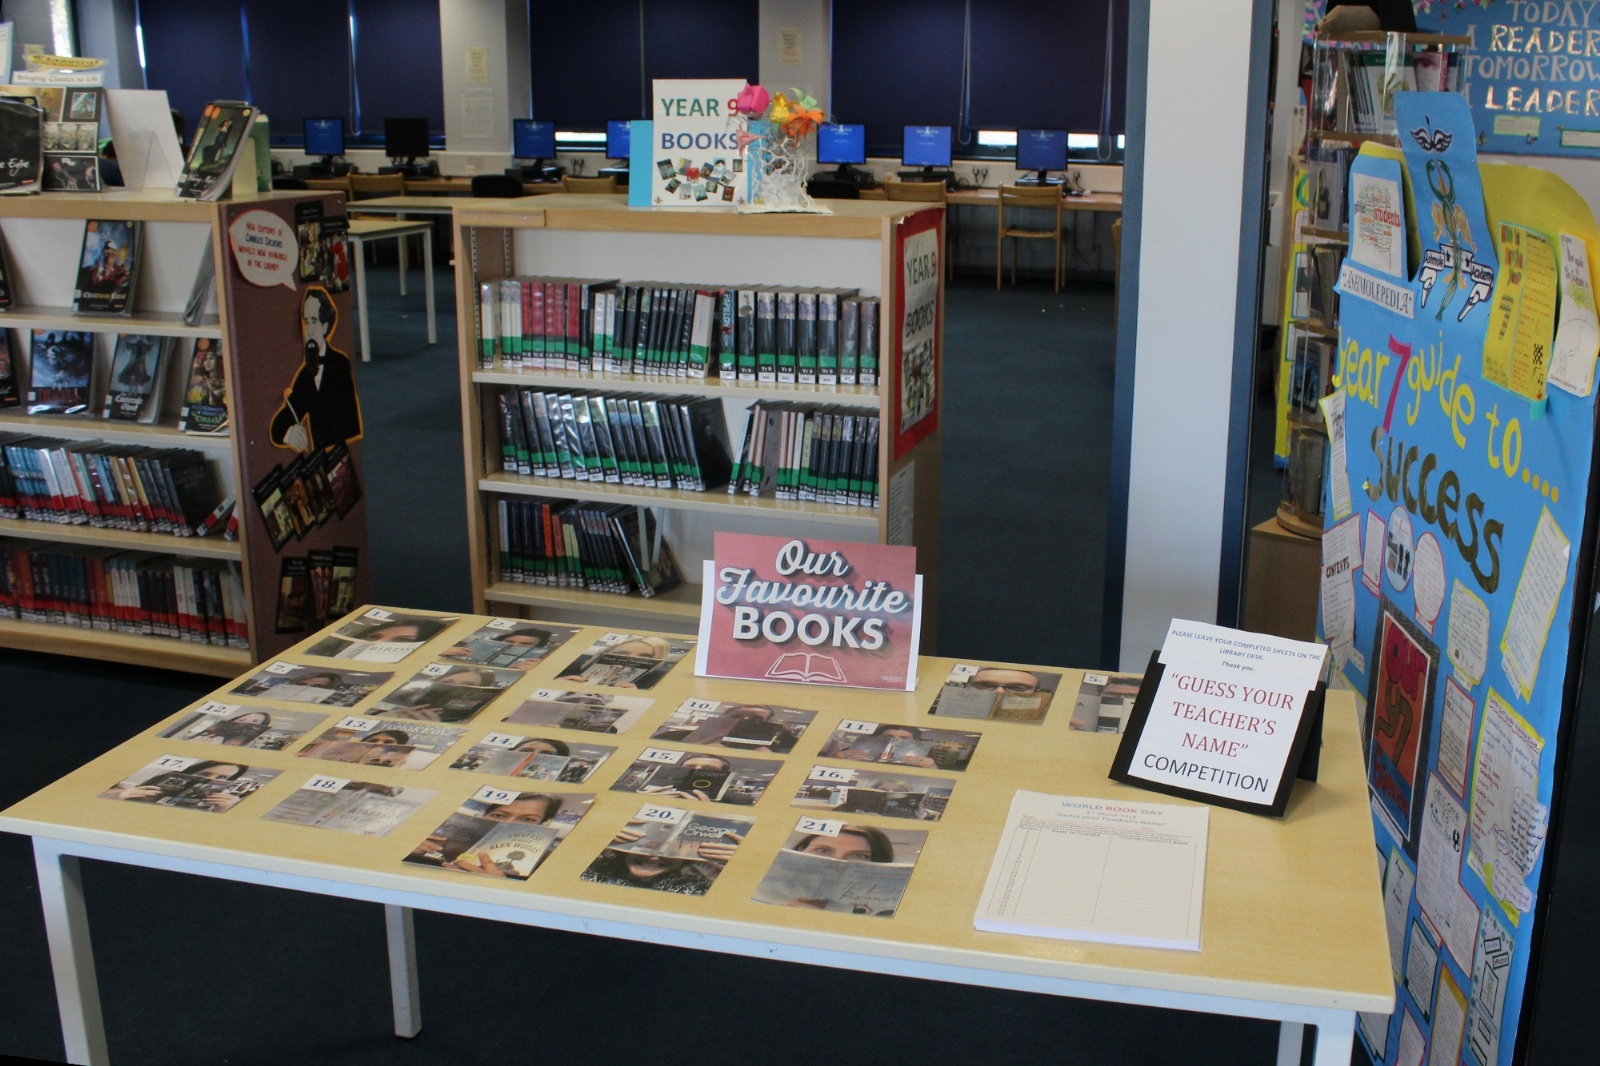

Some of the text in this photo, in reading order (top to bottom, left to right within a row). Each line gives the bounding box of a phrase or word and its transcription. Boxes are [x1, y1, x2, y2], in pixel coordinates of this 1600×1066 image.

[1505, 0, 1598, 28] TODAY
[1489, 24, 1600, 56] READER
[49, 74, 75, 82] Classics
[1484, 85, 1600, 116] LEADER
[661, 98, 739, 117] YEAR 9
[661, 132, 739, 150] BOOKS
[906, 251, 937, 287] YEAR 9
[1383, 334, 1412, 434] 7
[1406, 330, 1476, 450] guide
[775, 538, 850, 578] Our
[716, 566, 909, 615] Favourite
[732, 605, 886, 651] BOOKS
[1171, 629, 1194, 639] PLEASE
[1194, 633, 1214, 643] LEAVE
[1215, 637, 1233, 646] YOUR
[1233, 640, 1272, 653] COMPLETED
[1272, 646, 1296, 658] SHEETS
[1297, 651, 1308, 659] ON
[1219, 648, 1264, 661] LIBRARY DESK.
[1221, 660, 1255, 673] Thank you.
[1242, 685, 1295, 710] YOUR
[204, 704, 227, 714] 12.
[688, 701, 712, 710] 10.
[344, 719, 367, 729] 13.
[489, 736, 513, 746] 14.
[649, 751, 674, 761] 15.
[158, 757, 183, 769] 17.
[816, 768, 845, 780] 16.
[1144, 753, 1270, 793] COMPETITION
[311, 777, 336, 790] 18.
[481, 790, 510, 802] 19.
[644, 808, 674, 820] 20.
[1061, 802, 1102, 810] WORLD
[1106, 806, 1138, 814] BOOK
[688, 822, 737, 834] George
[801, 819, 835, 834] 21.
[684, 828, 725, 839] Orwell
